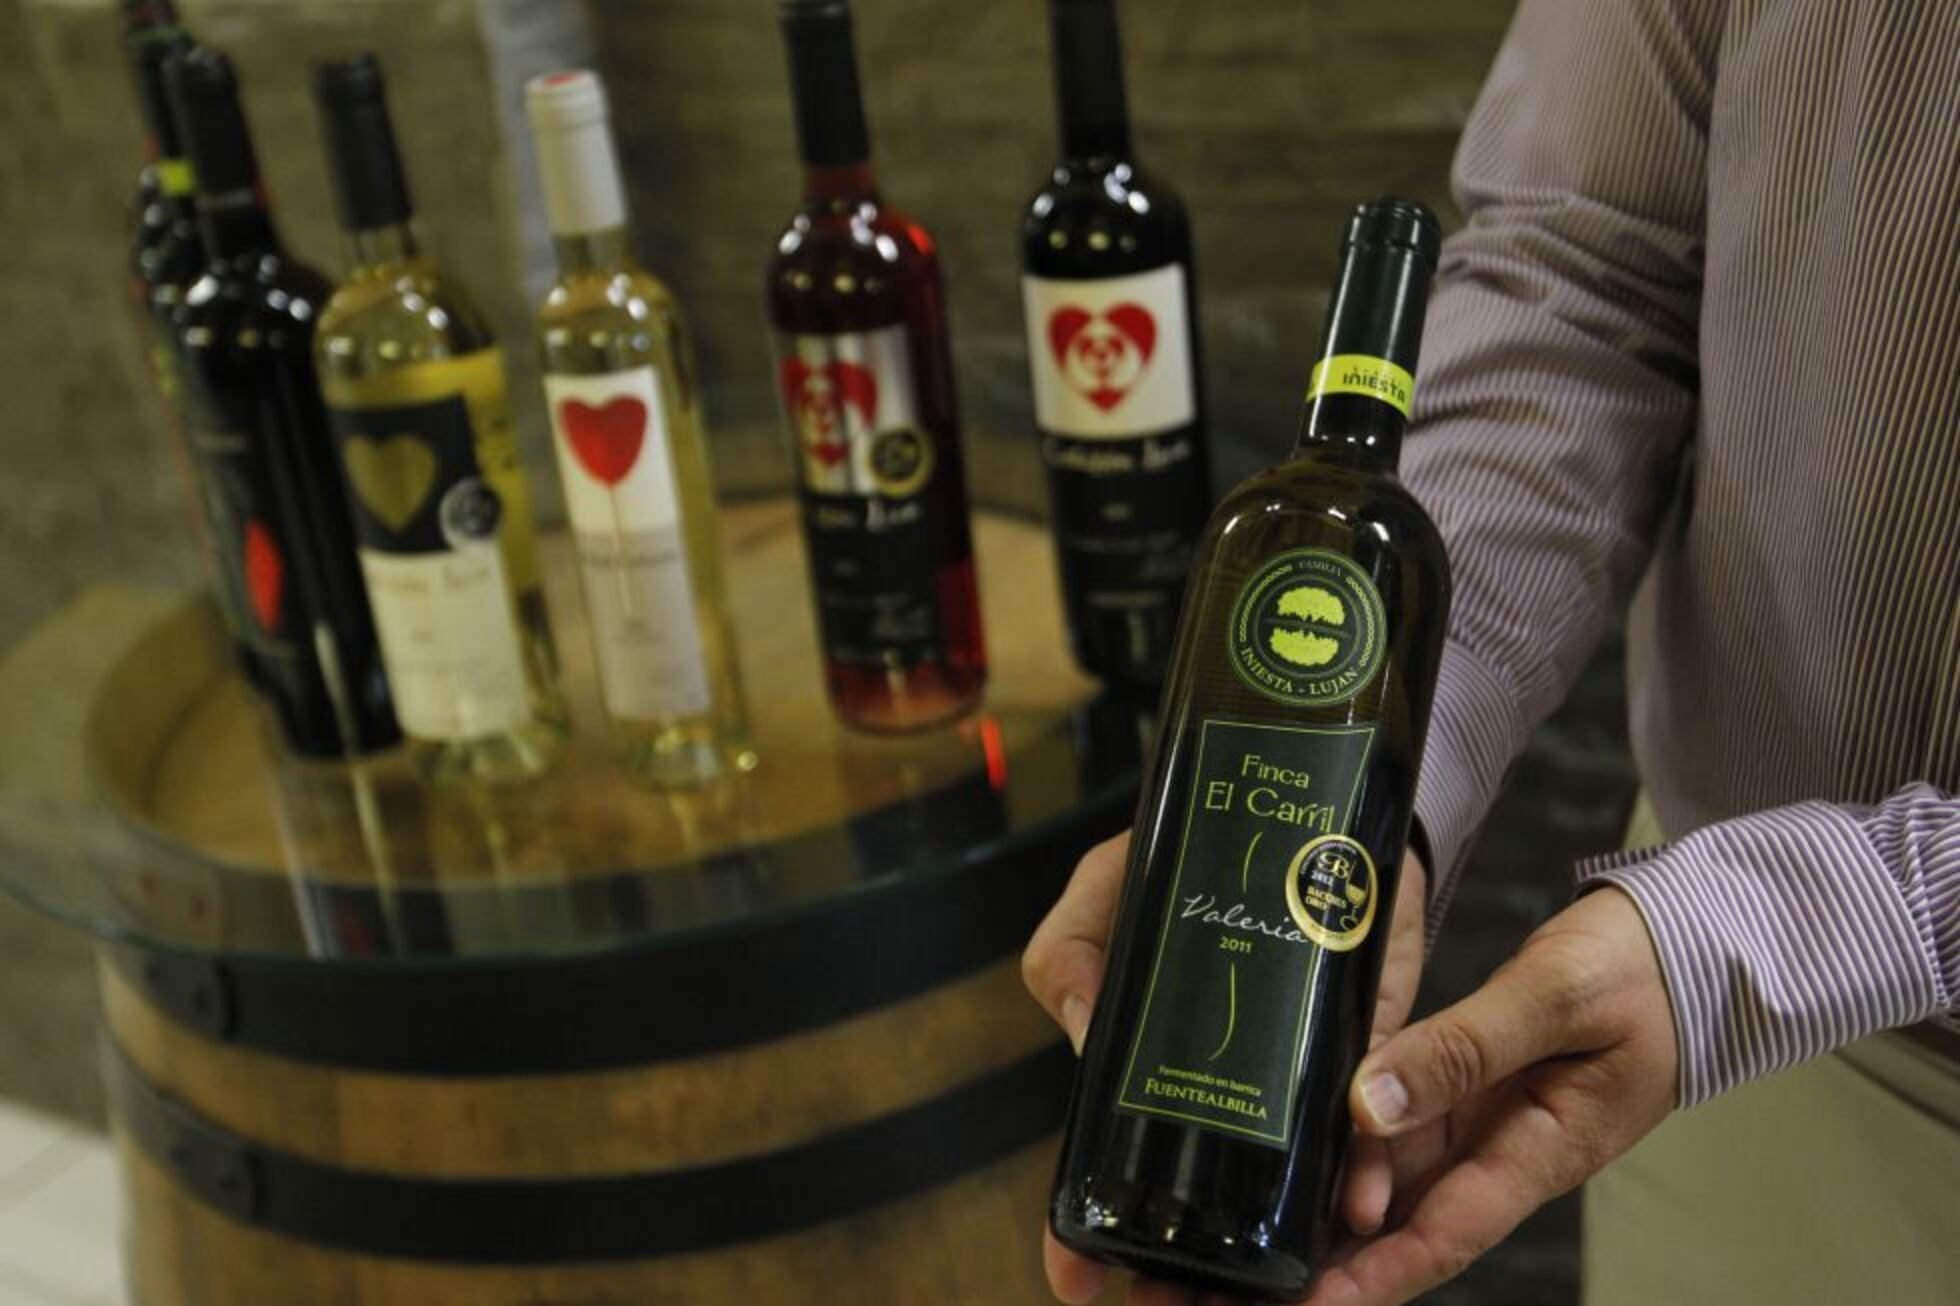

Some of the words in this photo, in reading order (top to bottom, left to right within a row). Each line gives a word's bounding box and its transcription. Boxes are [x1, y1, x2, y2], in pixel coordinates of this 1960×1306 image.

[1241, 647, 1293, 693] INIESTA
[1241, 754, 1310, 788] Finca
[1205, 781, 1234, 811] El
[1248, 787, 1335, 834] Carril
[1181, 894, 1309, 943] Valeria
[1219, 937, 1252, 953] 2011
[1145, 1077, 1267, 1120] FUENTEALBILLA
